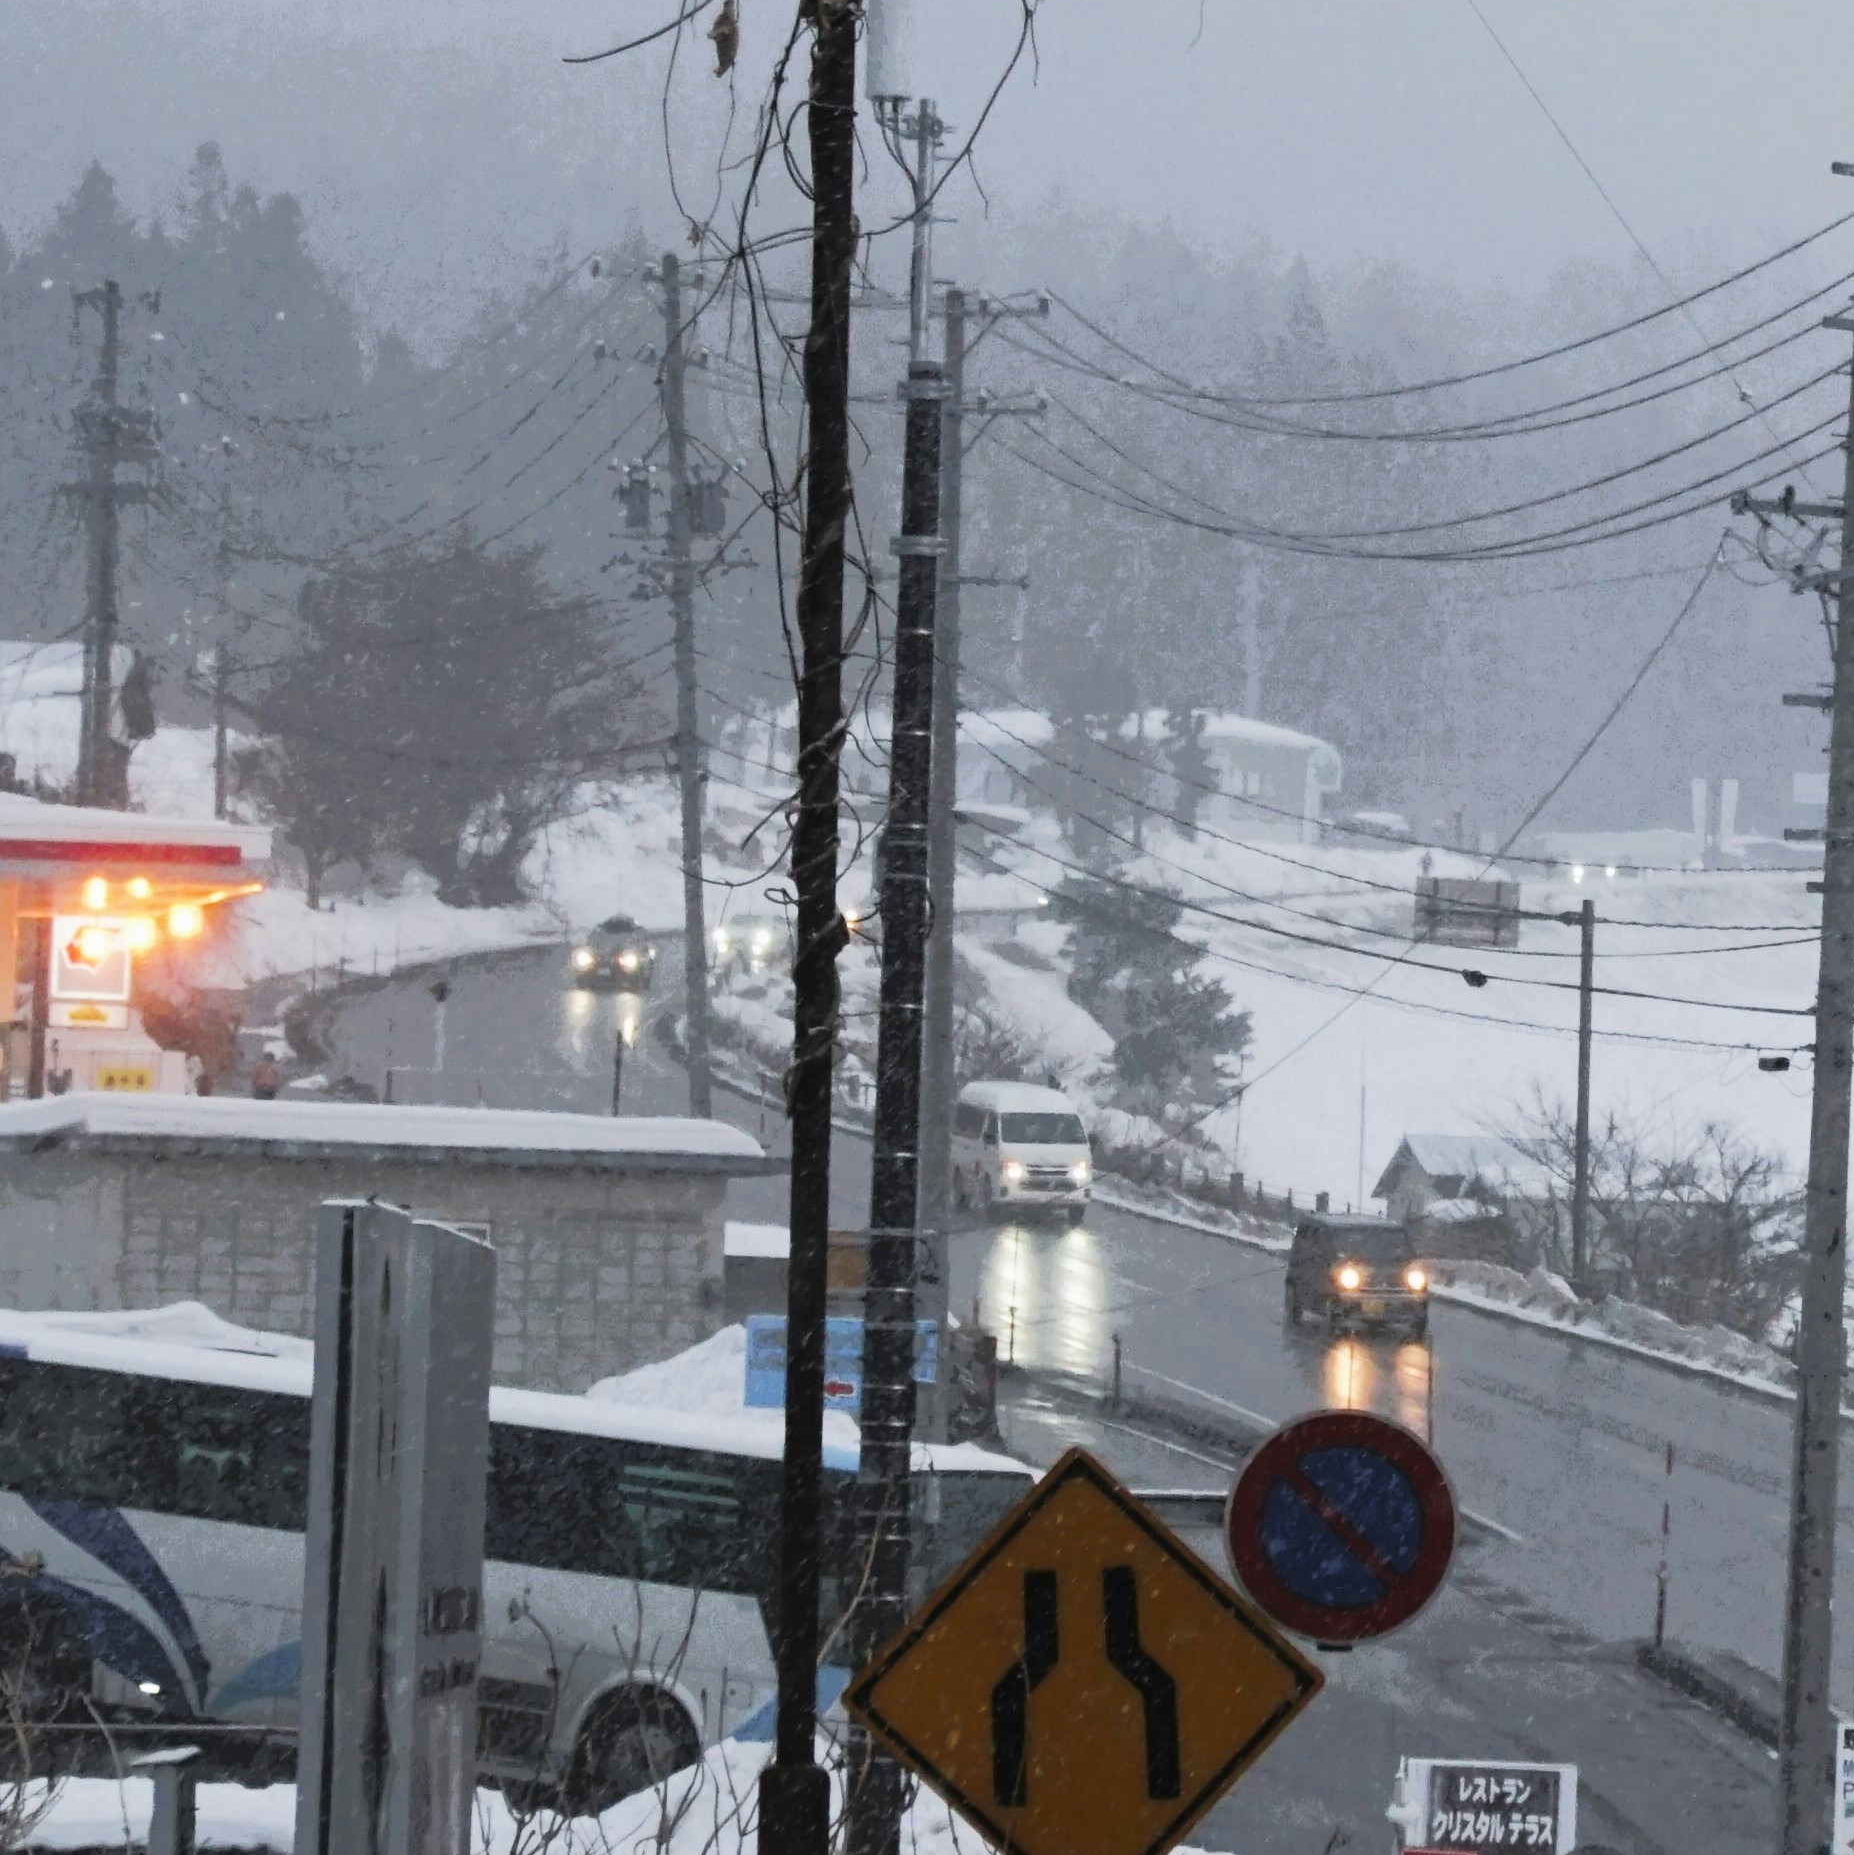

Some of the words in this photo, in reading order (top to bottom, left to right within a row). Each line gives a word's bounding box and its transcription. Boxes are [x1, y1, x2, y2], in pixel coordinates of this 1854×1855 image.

[1459, 1776, 1531, 1804] レストラン
